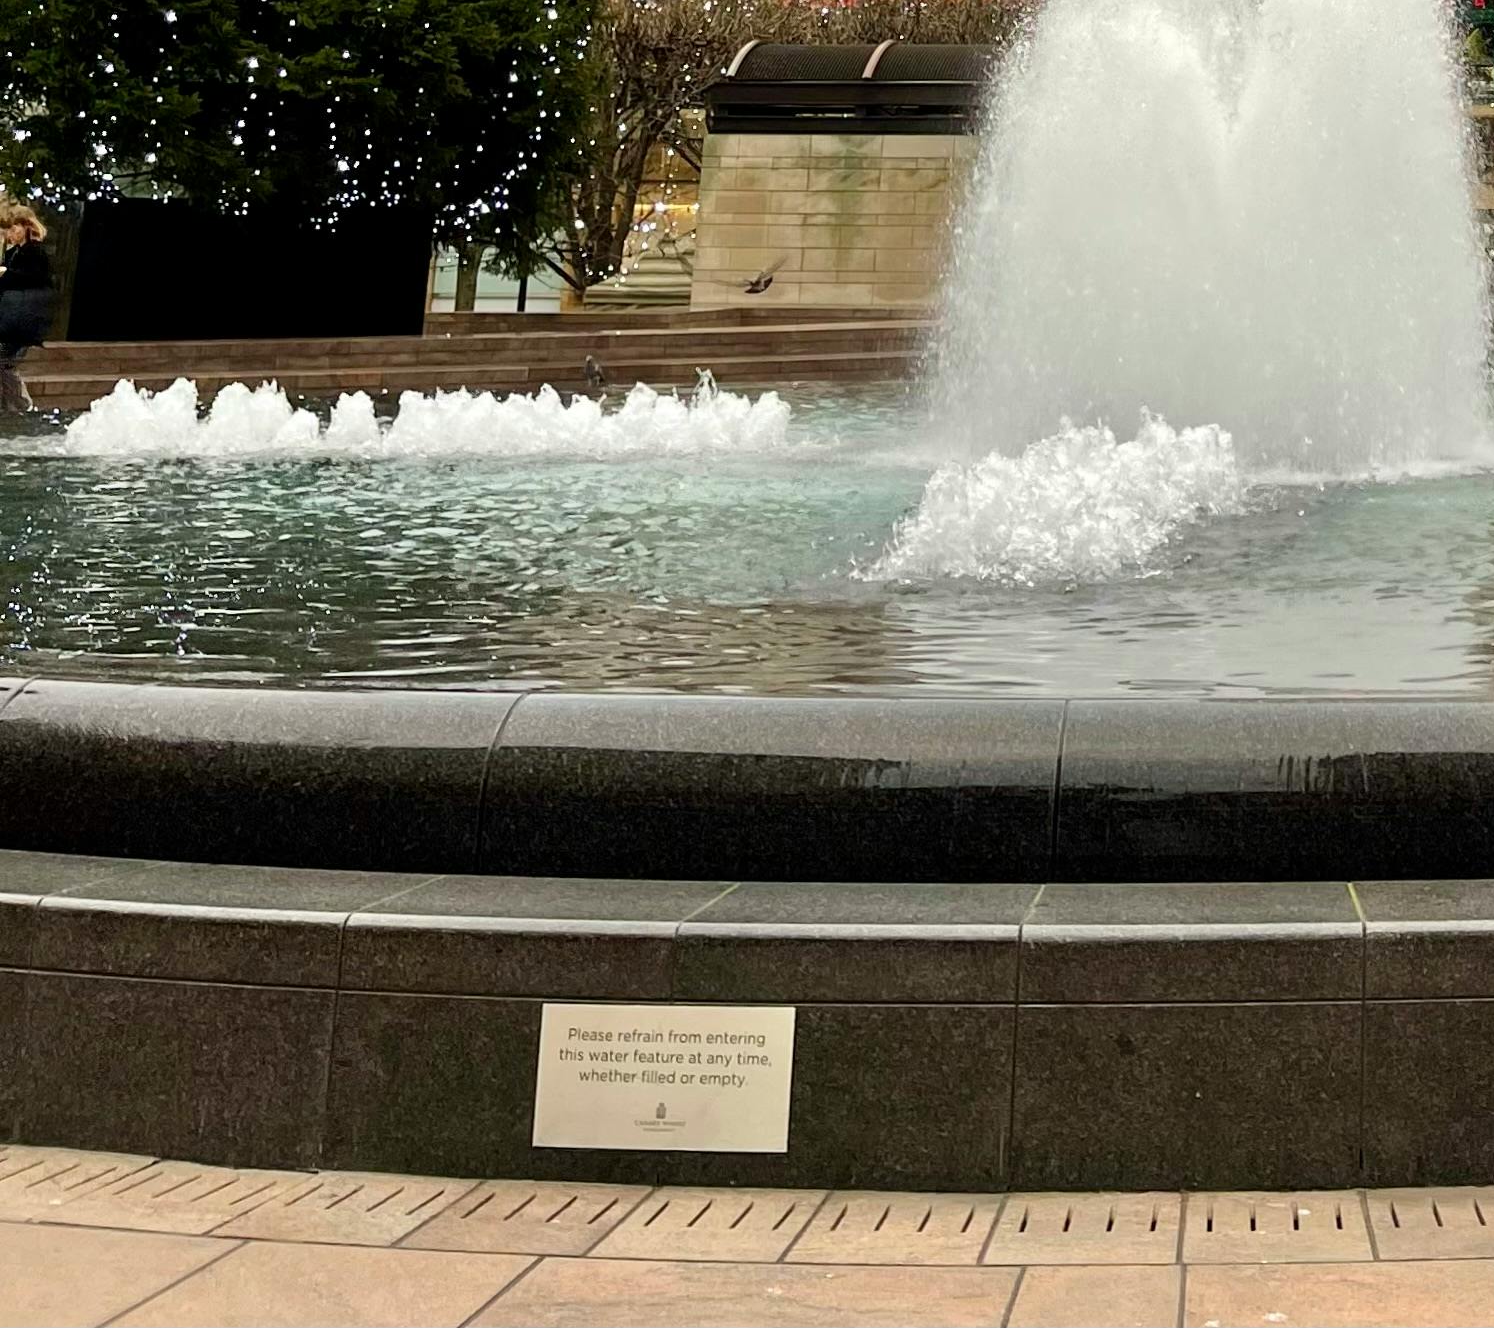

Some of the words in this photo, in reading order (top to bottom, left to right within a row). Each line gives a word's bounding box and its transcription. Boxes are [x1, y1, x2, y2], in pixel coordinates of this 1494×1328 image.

[568, 1027, 613, 1042] Please
[617, 1028, 664, 1043] refrain
[668, 1029, 702, 1043] from
[705, 1031, 766, 1048] entering
[559, 1047, 584, 1061] this
[589, 1049, 629, 1063] water
[633, 1048, 684, 1064] feature
[688, 1051, 702, 1064] at
[706, 1053, 732, 1068] any
[579, 1067, 638, 1083] whether
[641, 1069, 676, 1084] filled
[680, 1073, 696, 1085] or
